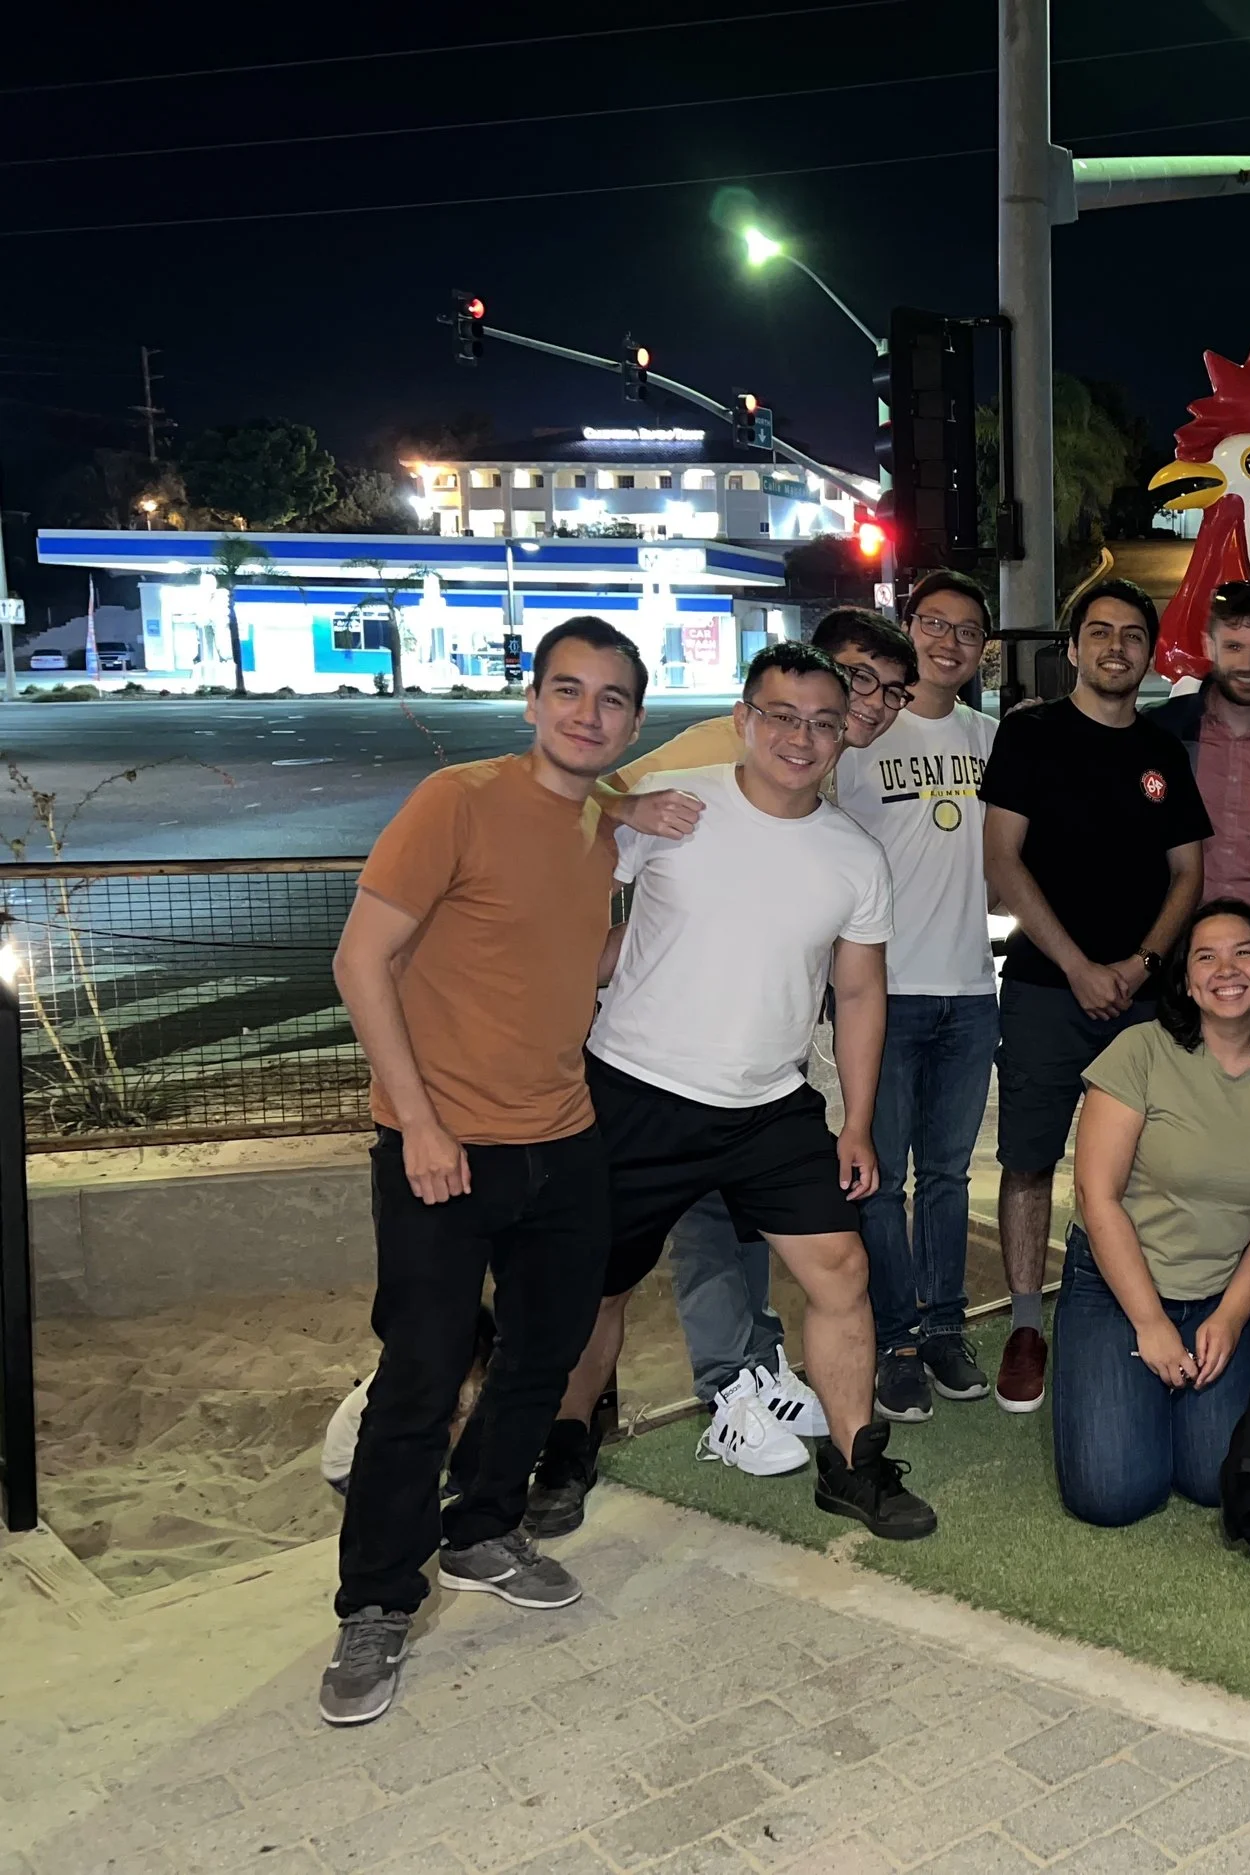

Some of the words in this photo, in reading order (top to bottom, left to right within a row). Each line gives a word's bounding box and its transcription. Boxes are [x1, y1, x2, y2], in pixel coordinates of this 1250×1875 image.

[688, 629, 712, 638] CAR
[879, 759, 906, 790] UC
[910, 755, 944, 787] SAN
